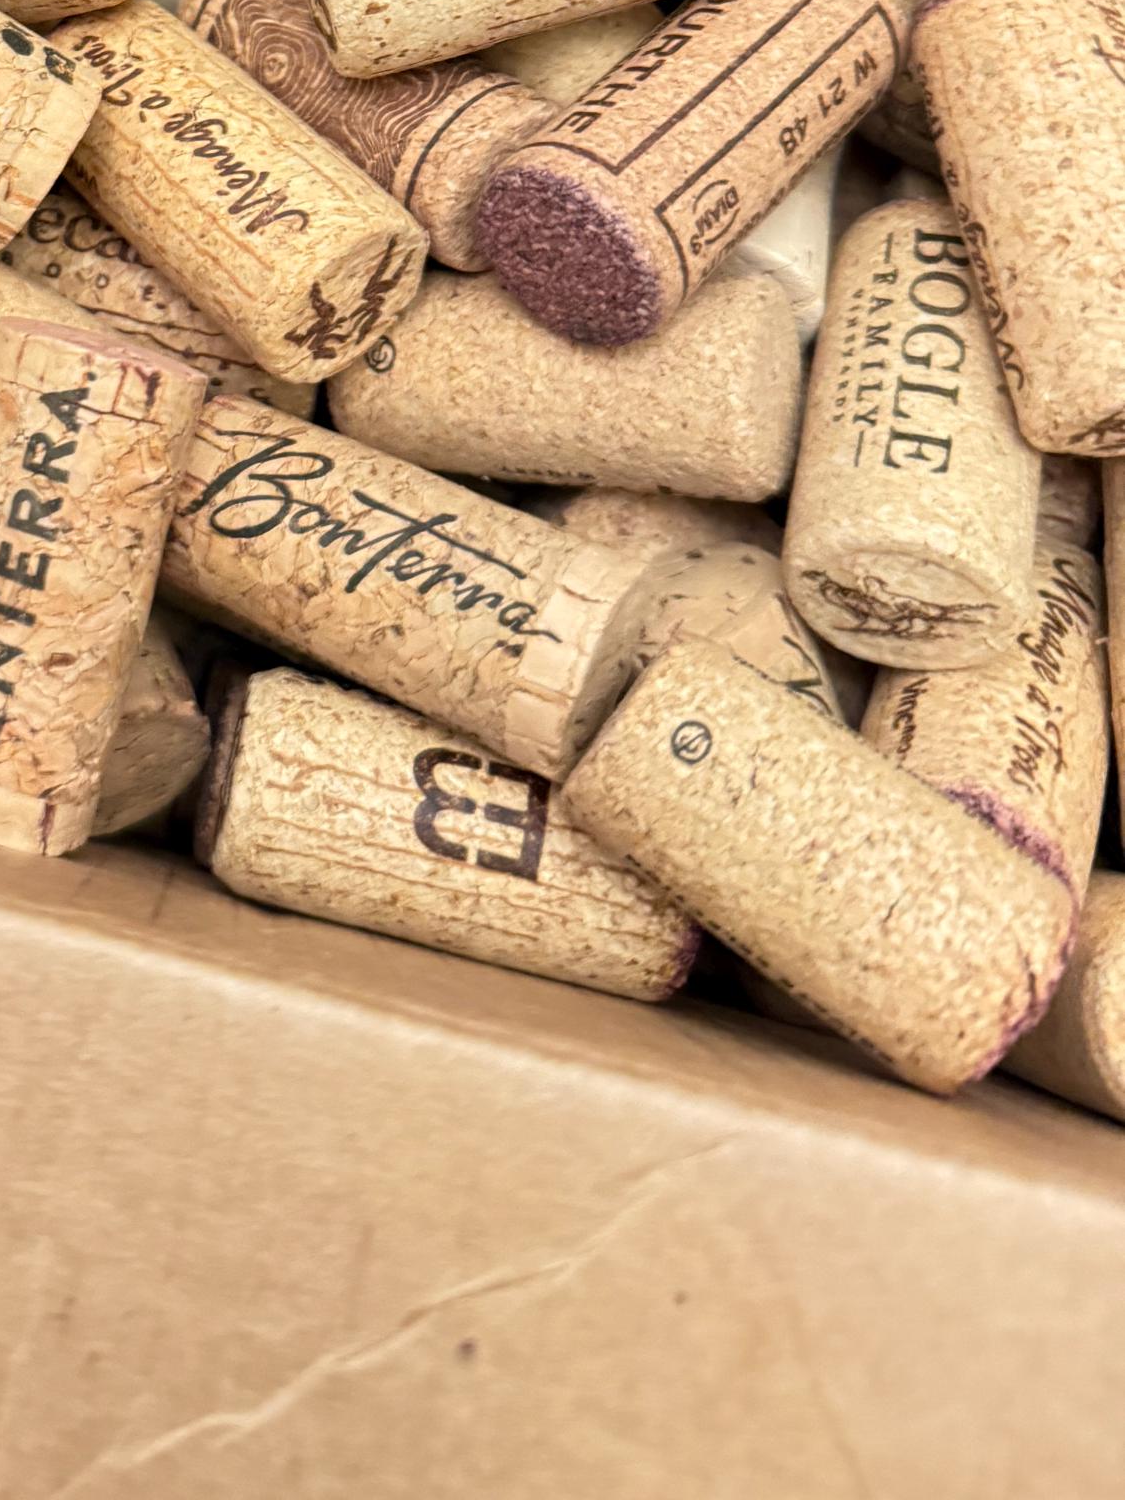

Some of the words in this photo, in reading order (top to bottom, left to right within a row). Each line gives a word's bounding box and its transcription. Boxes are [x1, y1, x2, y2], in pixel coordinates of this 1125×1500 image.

[816, 77, 849, 119] 21
[851, 49, 878, 85] W
[164, 113, 309, 235] Ménage
[778, 119, 810, 157] 48
[853, 268, 899, 428] FAMILY
[883, 228, 971, 474] BOGLE
[191, 429, 563, 644] Bonterra
